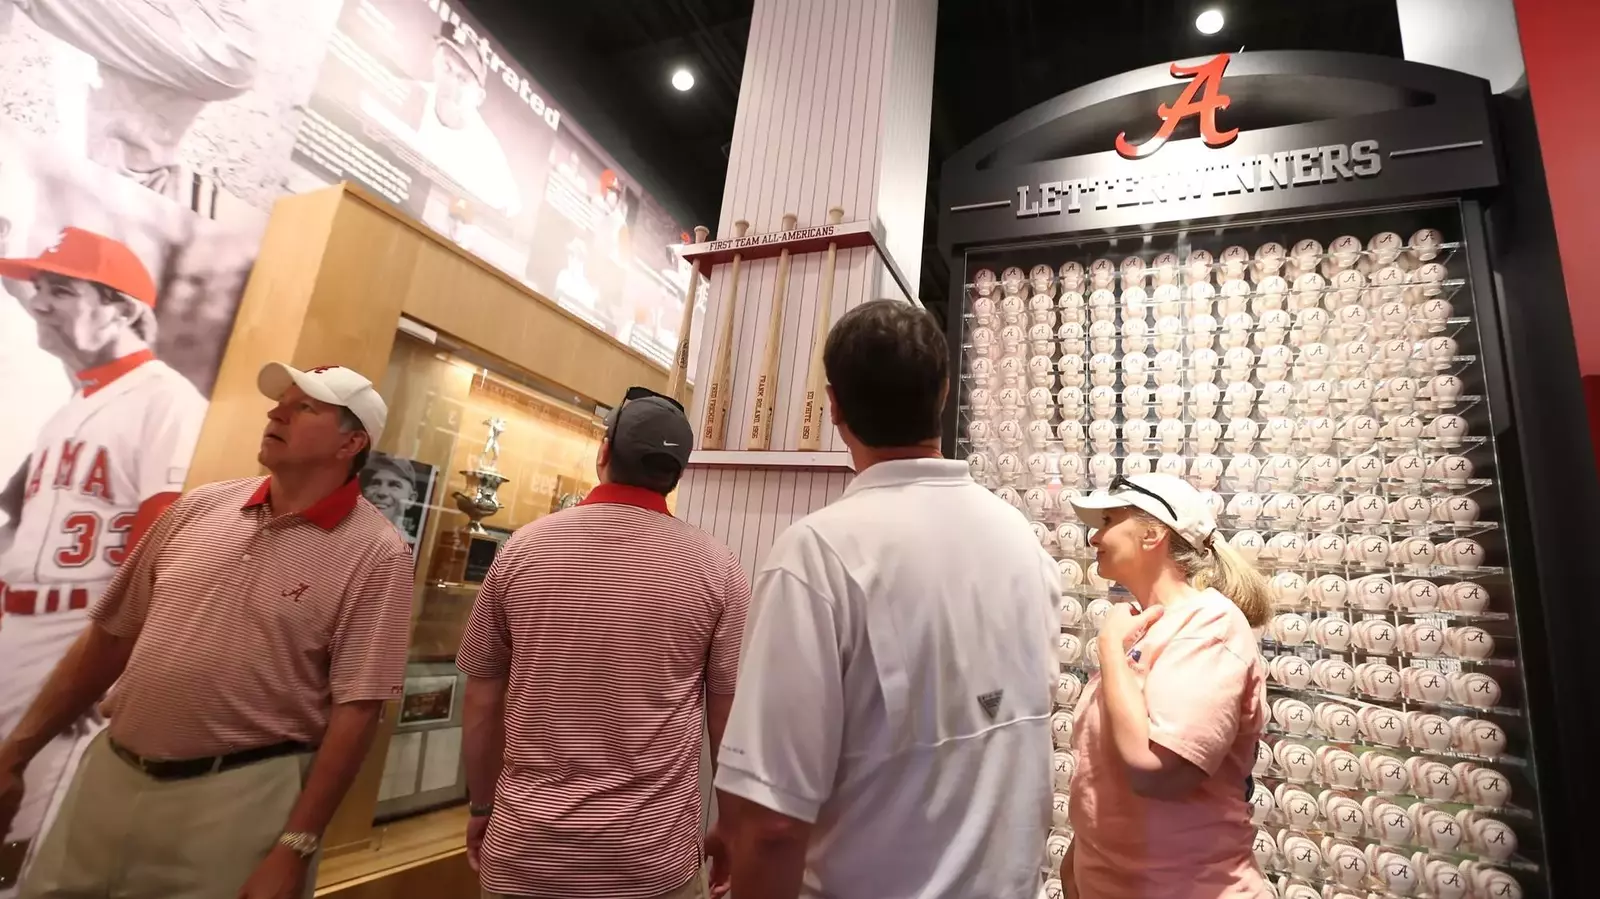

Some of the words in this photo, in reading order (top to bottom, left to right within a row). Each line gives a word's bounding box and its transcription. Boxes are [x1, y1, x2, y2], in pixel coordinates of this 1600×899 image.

[1115, 53, 1239, 160] A
[1016, 140, 1382, 217] LETTERWINNERS
[709, 238, 732, 251] FIRST
[734, 235, 760, 248] TEAM
[762, 226, 834, 244] ALL-AMERICANS
[757, 375, 767, 397] FRANK
[807, 391, 815, 399] ED
